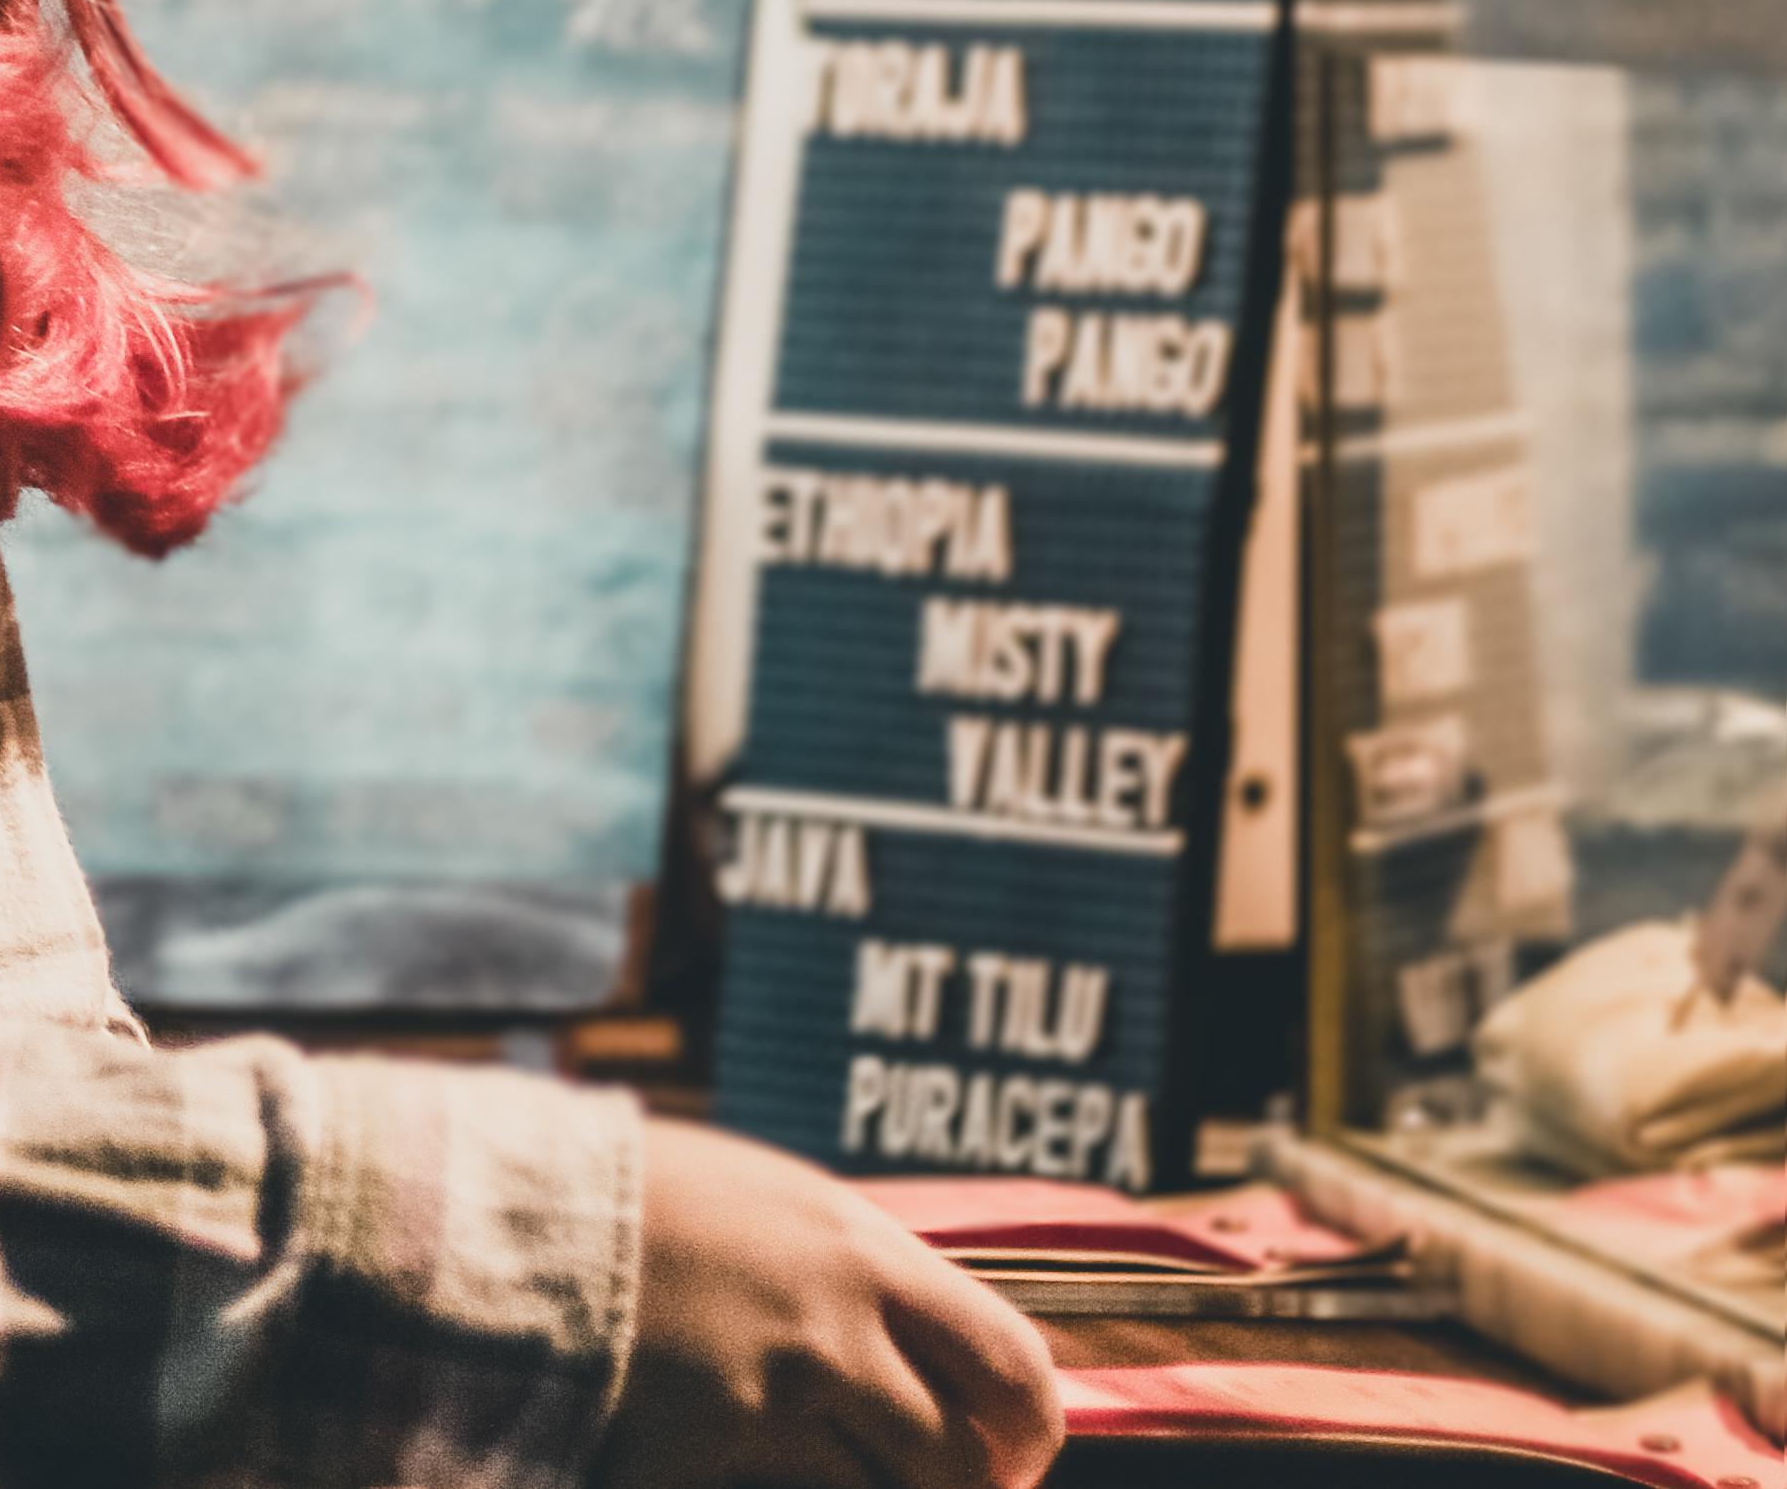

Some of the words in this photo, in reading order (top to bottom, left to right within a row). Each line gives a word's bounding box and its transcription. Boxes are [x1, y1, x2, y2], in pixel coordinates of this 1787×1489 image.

[795, 34, 1029, 147] TORAJA
[995, 185, 1208, 297] PANGO
[1022, 306, 1233, 418] PANGO
[751, 463, 1011, 582] ETHIOPIA
[916, 595, 1118, 706] MISTY
[944, 715, 1187, 828] VALLEY
[714, 810, 870, 918] JAVA
[848, 937, 955, 1042] MT
[966, 948, 1110, 1065] TILU
[840, 1053, 1150, 1192] PURACEPA
